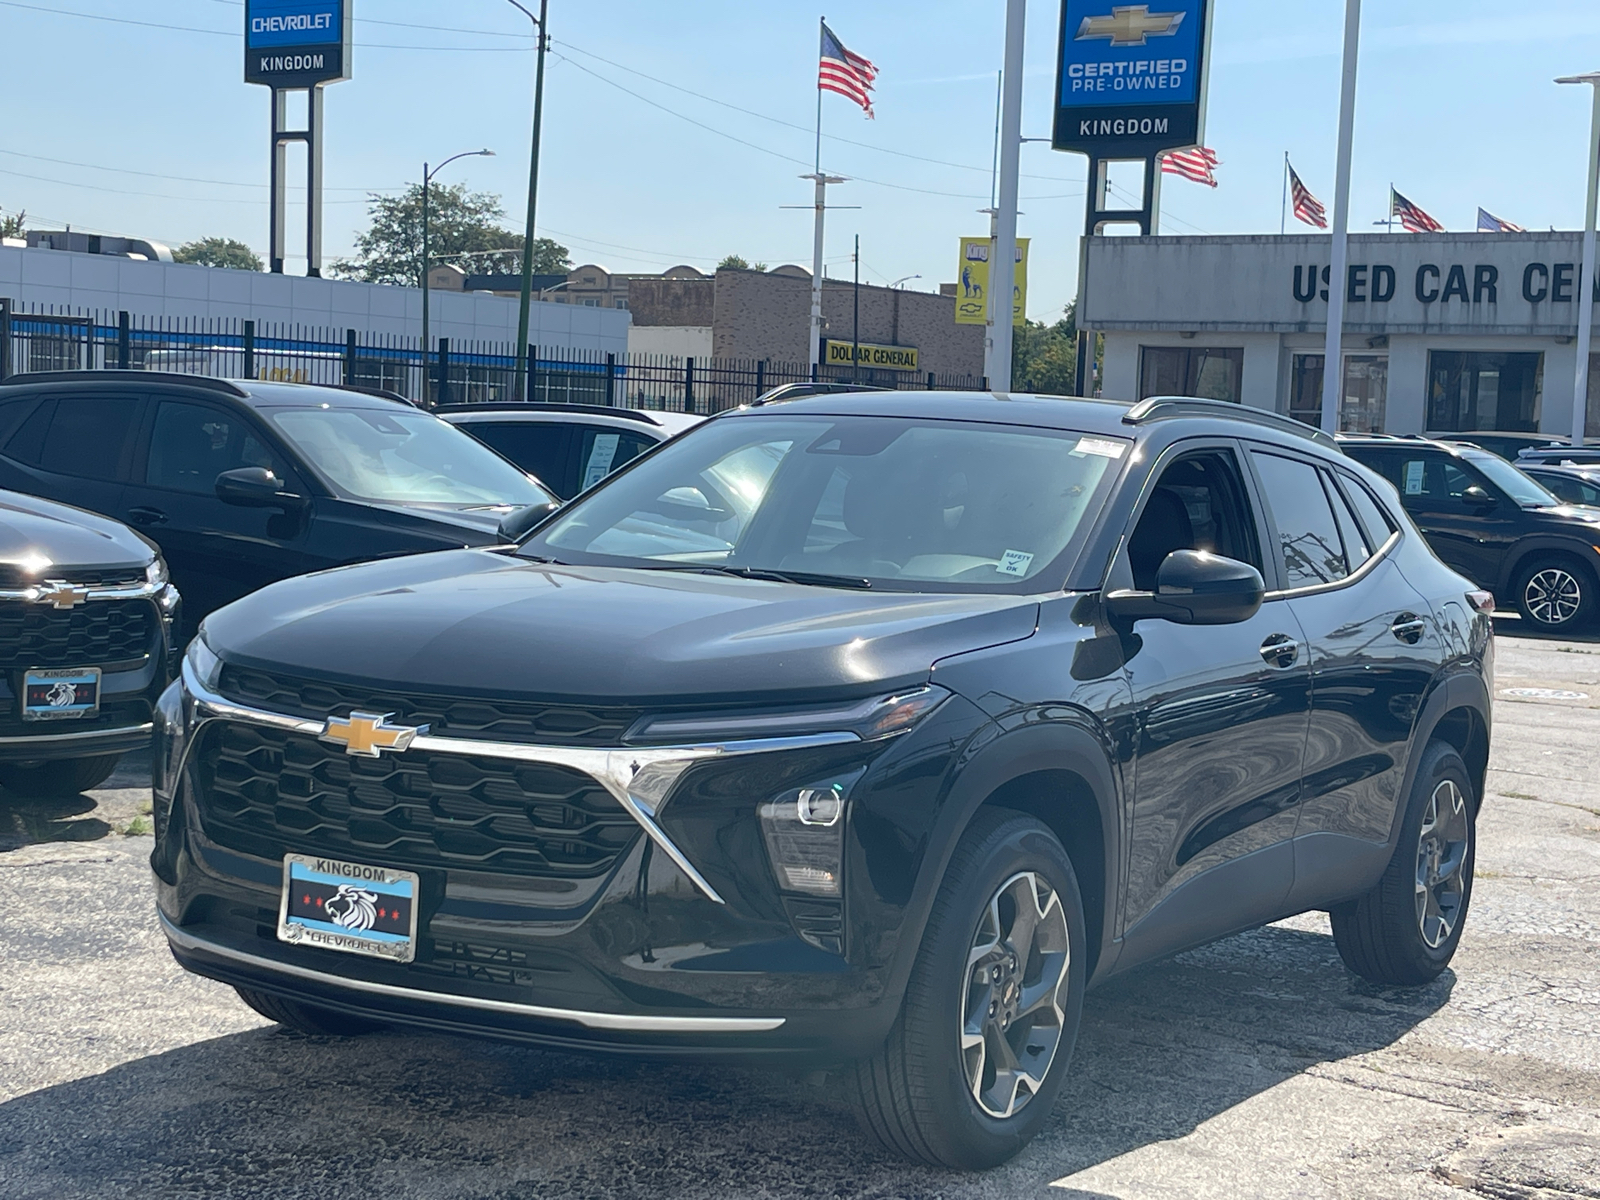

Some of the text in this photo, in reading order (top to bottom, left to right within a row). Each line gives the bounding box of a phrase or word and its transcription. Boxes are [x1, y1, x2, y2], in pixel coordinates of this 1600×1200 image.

[252, 13, 332, 32] CHEVROLET
[261, 54, 324, 71] KINGDOM
[1068, 59, 1187, 77] CERTIFIED
[1072, 75, 1181, 92] PRE-OWNED
[1080, 118, 1168, 135] KINGDOM
[1415, 263, 1498, 303] CAR
[873, 349, 915, 366] GENERAL
[1005, 552, 1031, 561] SAFETY
[316, 859, 385, 882] KINGDOM
